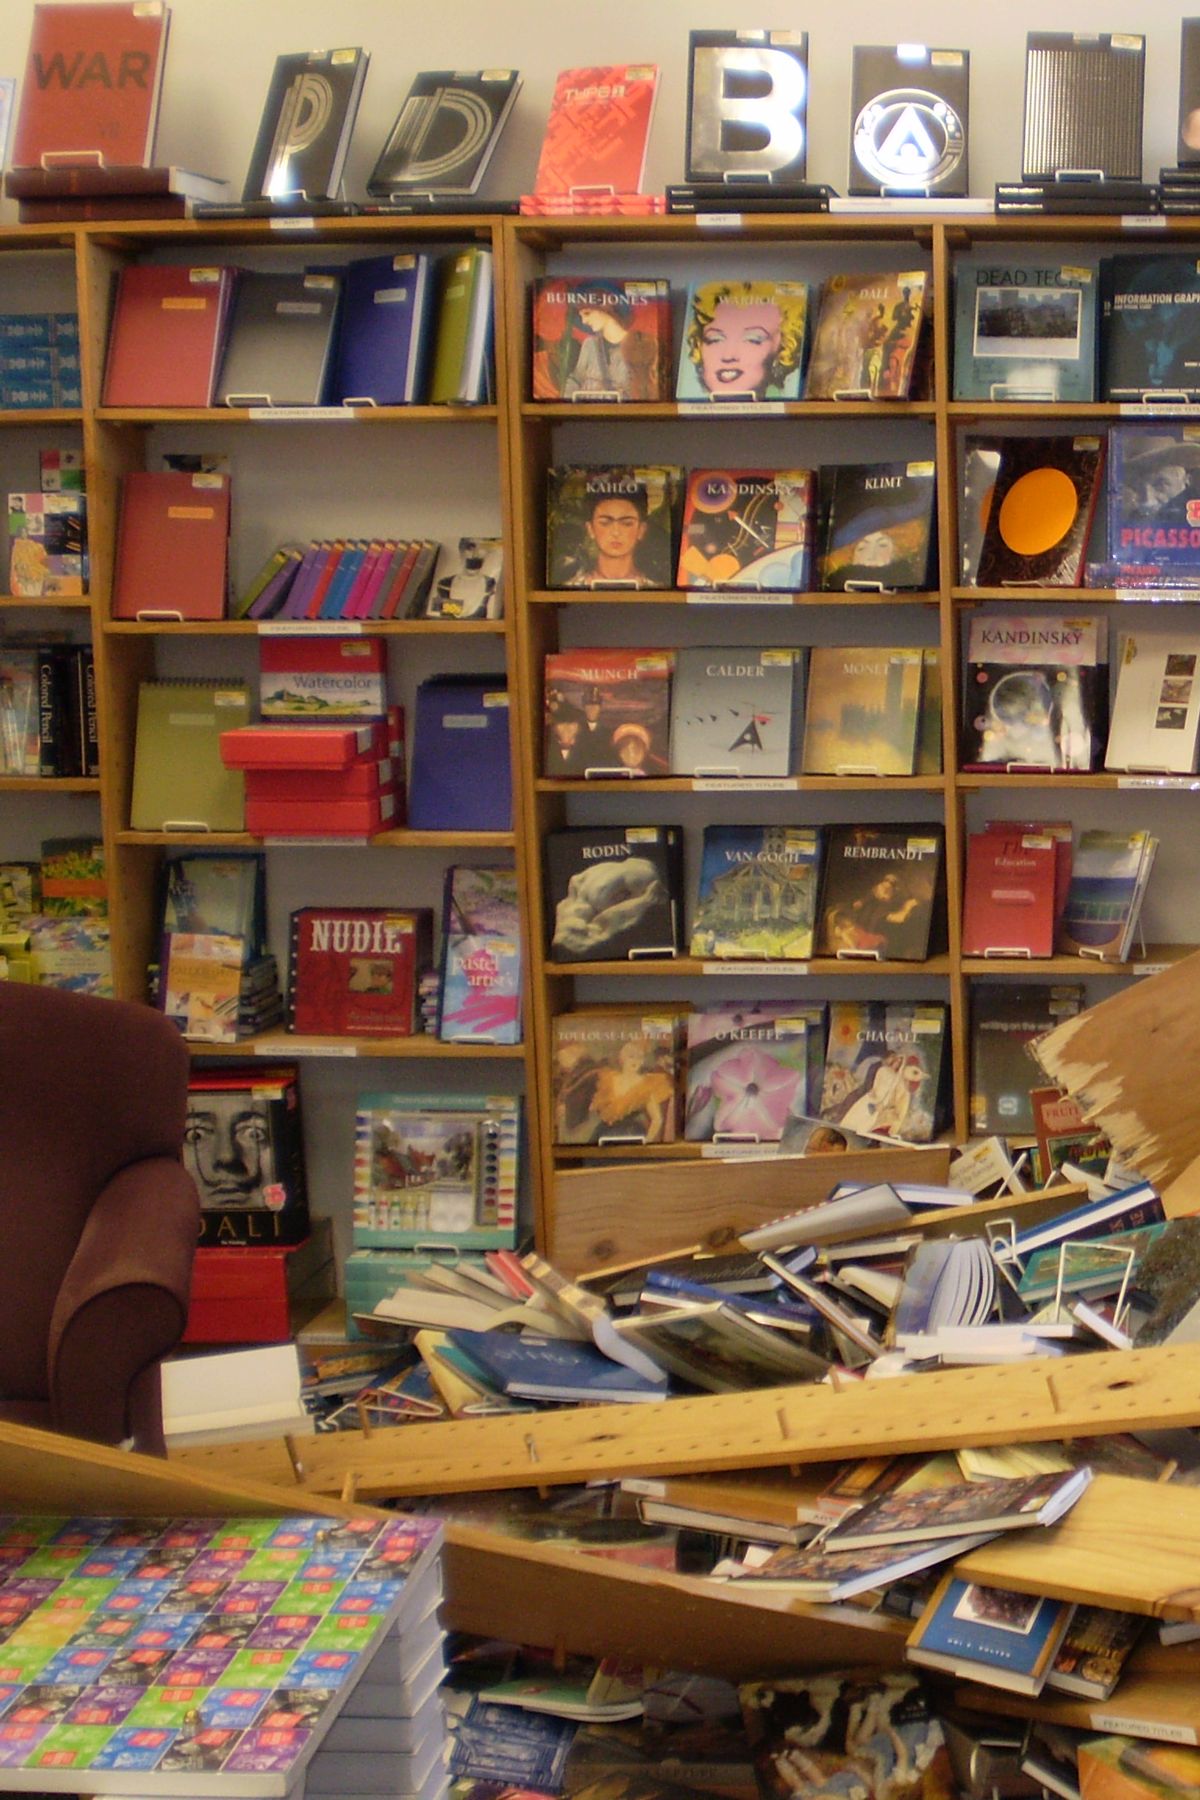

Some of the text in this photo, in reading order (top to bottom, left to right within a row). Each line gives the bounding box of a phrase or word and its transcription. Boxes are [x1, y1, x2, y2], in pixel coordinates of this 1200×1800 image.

[33, 51, 149, 90] WAR
[975, 269, 1083, 288] DEAD TEC
[546, 291, 649, 307] BURNE-JONES
[718, 294, 777, 306] WARHOL
[859, 287, 889, 300] DALI
[1114, 293, 1172, 306] INFORMATION
[585, 481, 639, 494] KAHLO
[707, 481, 795, 496] KANDINSKY
[864, 476, 903, 491] KLIMT
[981, 629, 1083, 646] KANDINSKY
[580, 667, 638, 681] MUNCH
[706, 663, 766, 678] CALDER
[843, 662, 890, 676] MONET
[41, 664, 52, 708] Colored
[294, 676, 372, 688] Watercolor
[41, 712, 53, 743] Pencil
[582, 843, 633, 860] RODIN
[724, 850, 800, 864] VAN GOGH
[843, 845, 924, 861] REMBRANDT
[310, 919, 402, 953] NUDIE
[452, 955, 498, 976] pastel
[558, 1031, 671, 1042] TOULOUSE-LAUTREC
[856, 1030, 921, 1044] CHAGALL
